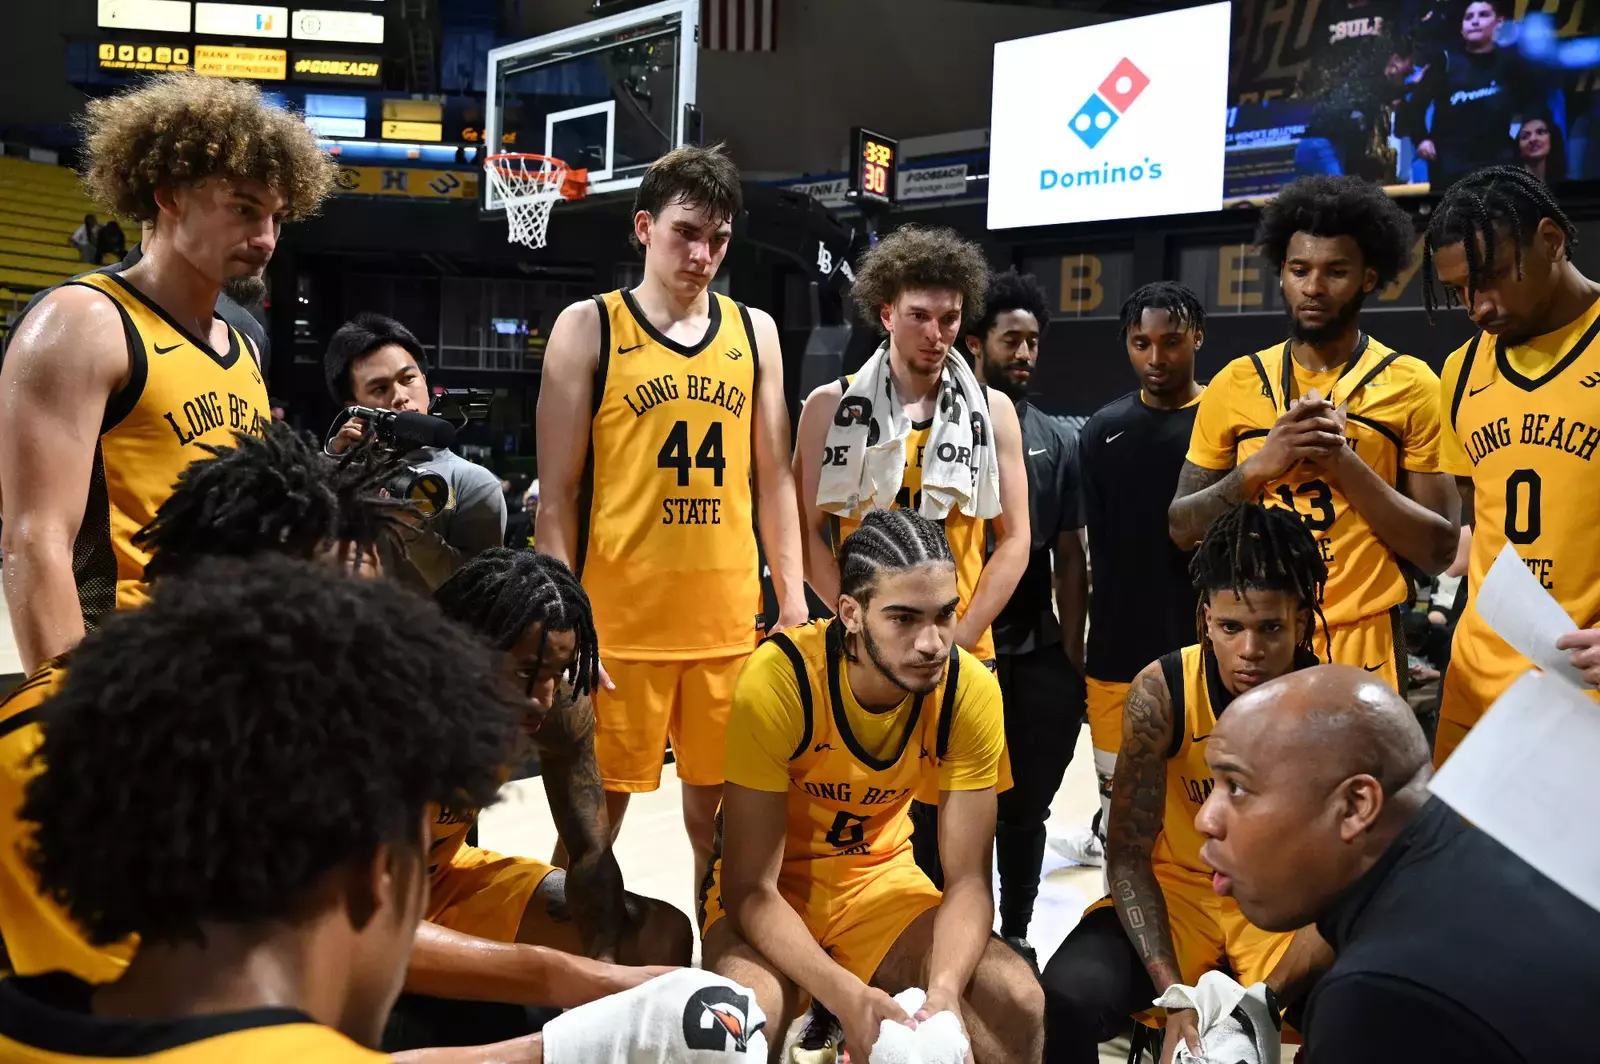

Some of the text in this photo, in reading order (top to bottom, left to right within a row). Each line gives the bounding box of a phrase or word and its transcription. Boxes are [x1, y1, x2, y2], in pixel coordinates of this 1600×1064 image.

[197, 50, 229, 59] THANK
[259, 53, 285, 62] FANS
[201, 63, 280, 74] AND SPONSORS
[295, 59, 379, 77] #GOBEACH
[864, 163, 886, 193] 30
[1039, 157, 1163, 190] Domino's
[1060, 254, 1103, 312] B
[623, 374, 747, 419] LONG BEACH
[163, 391, 265, 447] LONG BEA
[657, 420, 727, 488] 44
[1464, 413, 1600, 468] LONG BEACH
[662, 498, 721, 525] STATE
[1504, 468, 1542, 545] 0
[1180, 775, 1215, 806] LON
